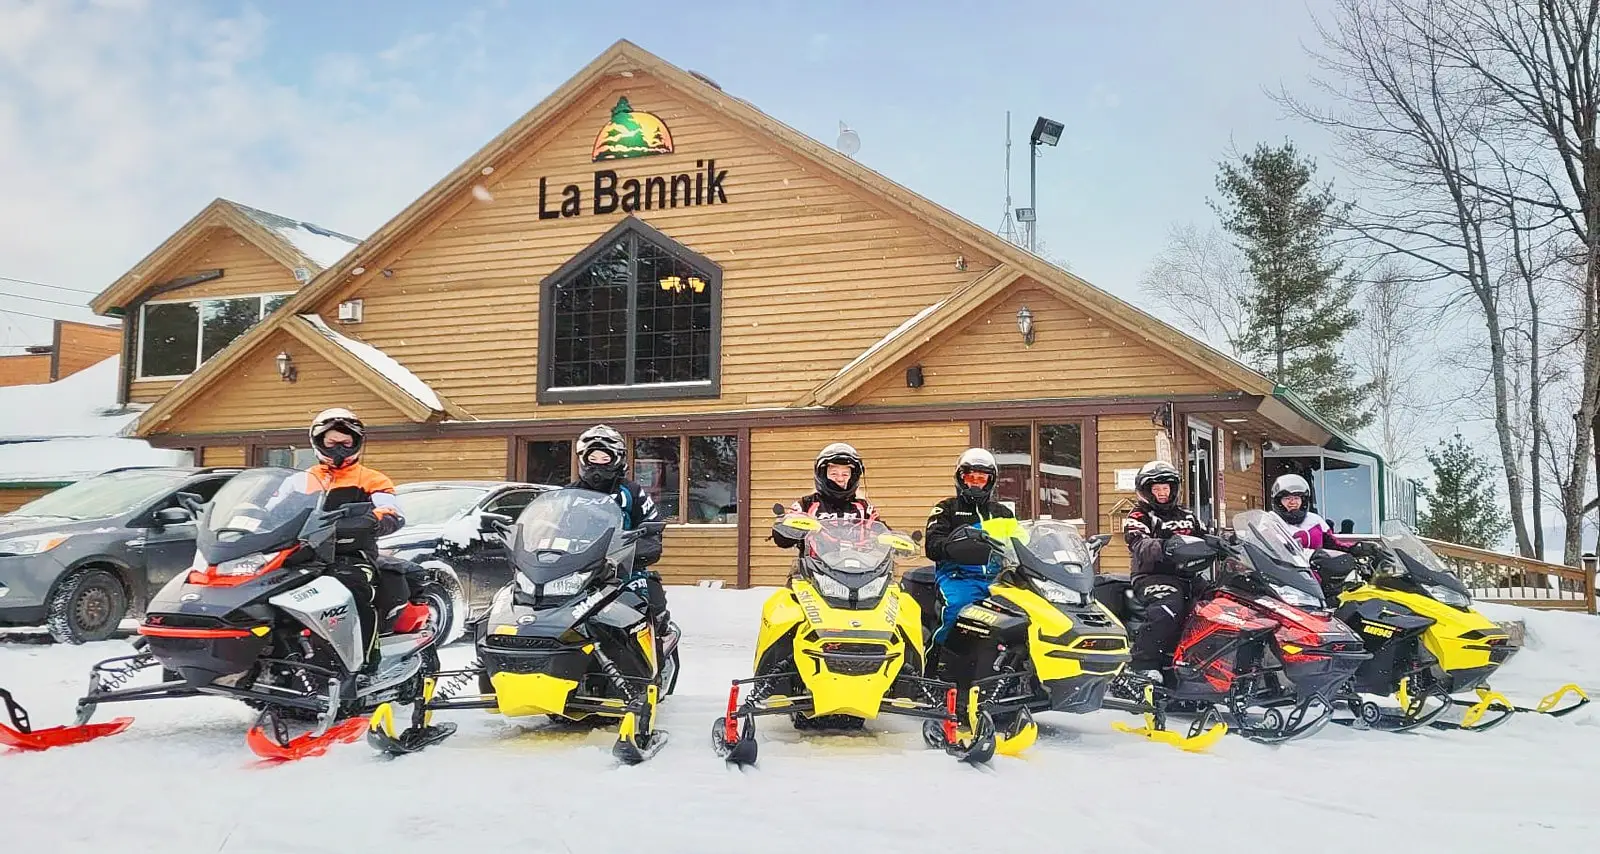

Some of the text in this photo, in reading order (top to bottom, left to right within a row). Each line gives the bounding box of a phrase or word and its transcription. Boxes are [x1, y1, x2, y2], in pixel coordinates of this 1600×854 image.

[538, 158, 729, 220] La Bannik
[1161, 519, 1194, 530] FXR
[320, 604, 348, 620] MXZ
